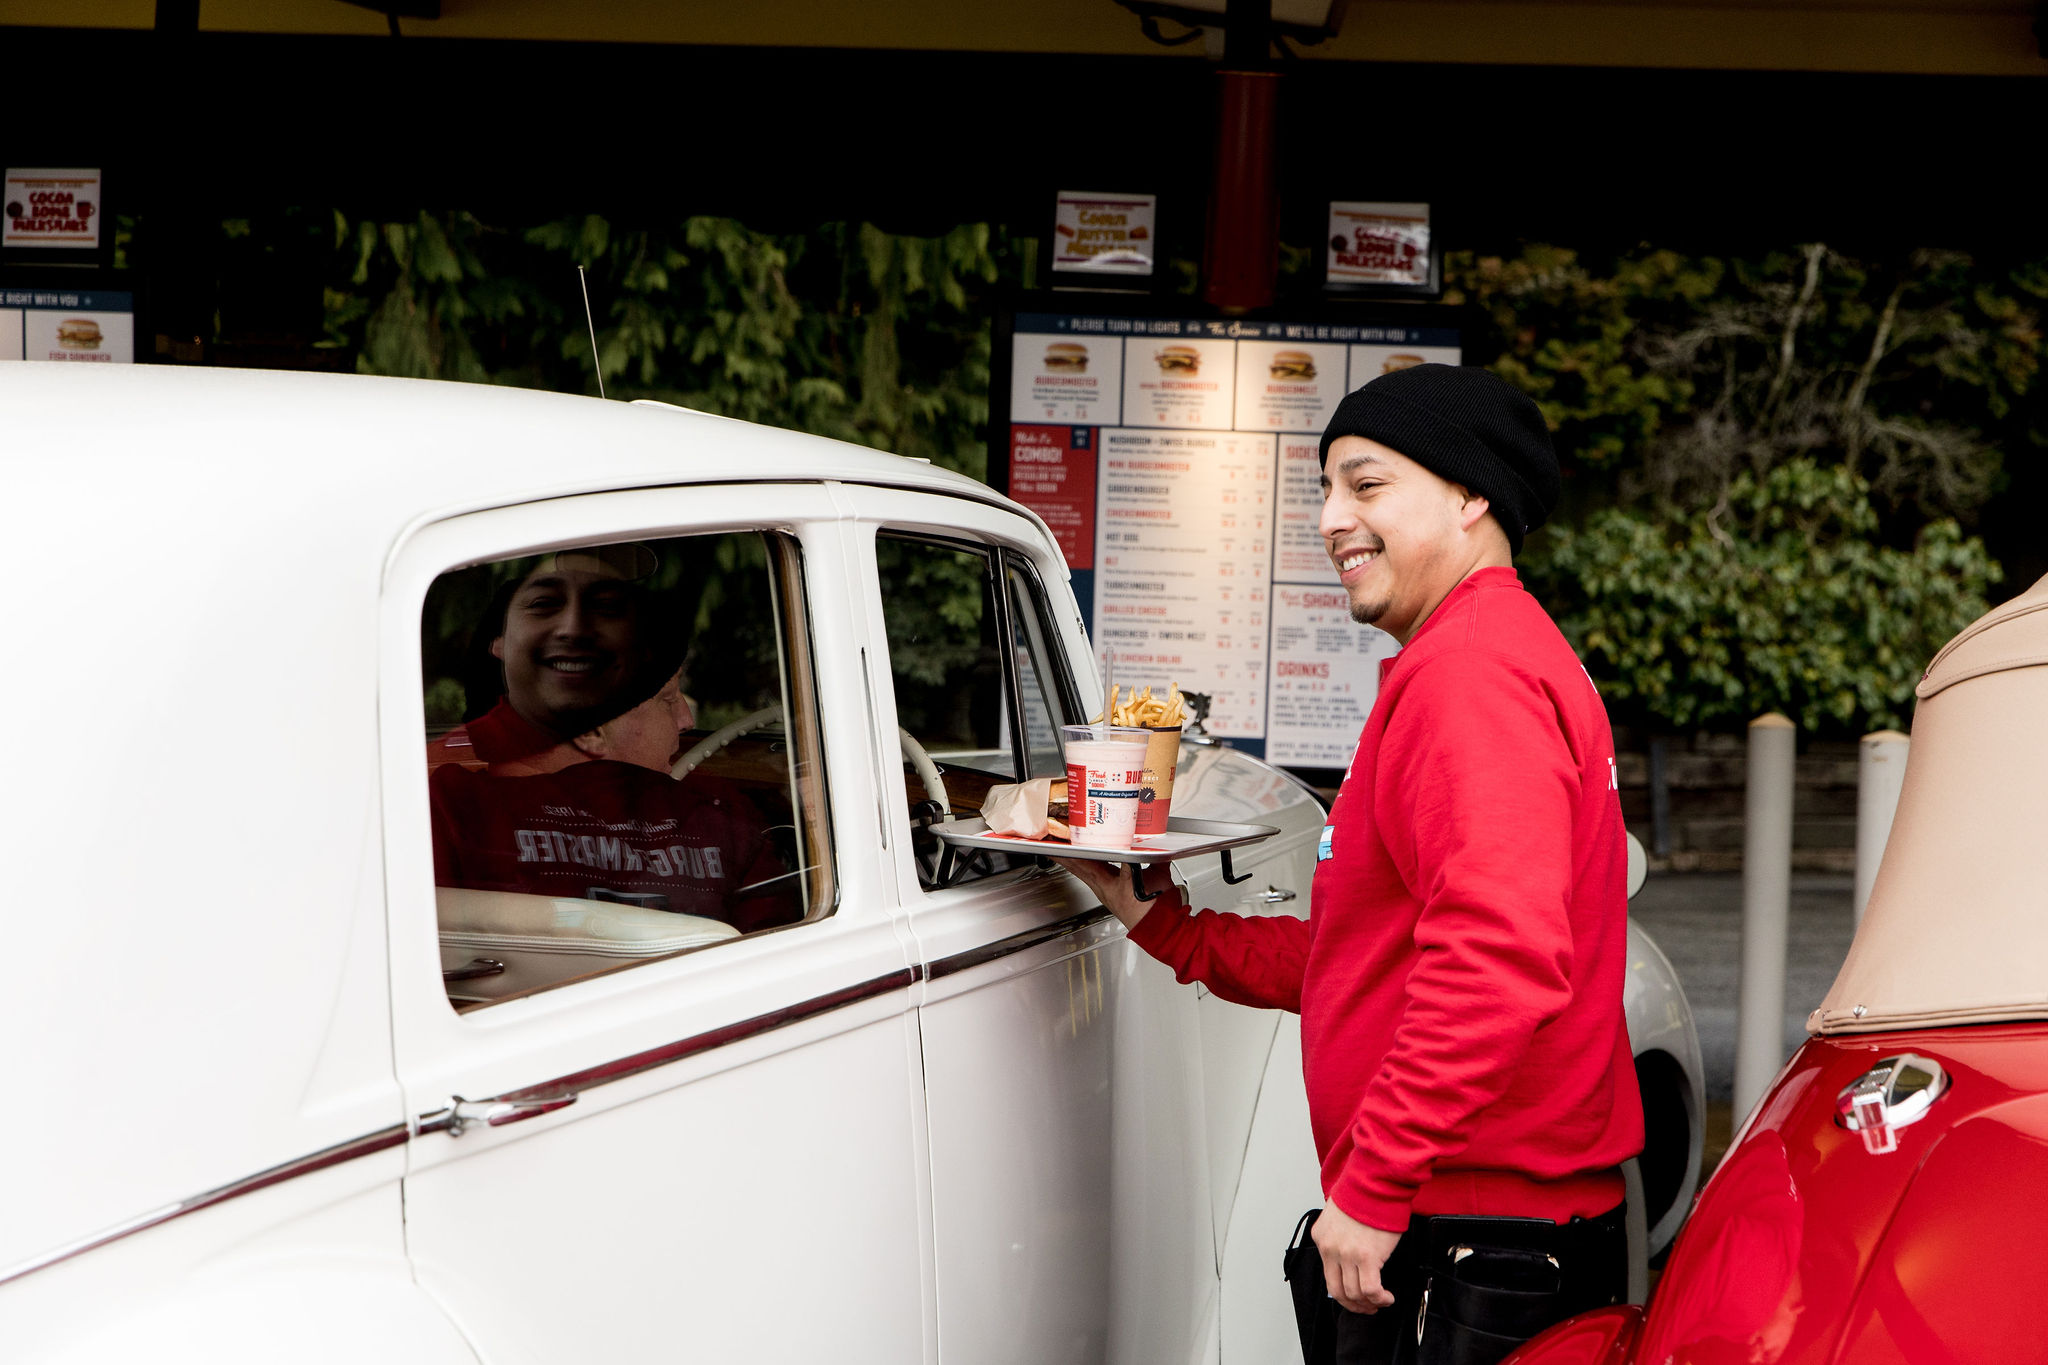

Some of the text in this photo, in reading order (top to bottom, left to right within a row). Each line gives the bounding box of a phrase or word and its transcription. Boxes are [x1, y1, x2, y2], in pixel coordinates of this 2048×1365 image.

[29, 192, 74, 204] COCOA
[6, 292, 33, 304] RIGHT
[34, 293, 58, 305] WITH
[59, 294, 79, 306] YOU
[1070, 318, 1104, 331] PLEASE
[1107, 319, 1131, 332] TURN
[1133, 320, 1146, 332] ON
[1148, 320, 1180, 334] LIGHTS
[1316, 327, 1328, 339] BE
[1331, 328, 1358, 340] RIGHT
[1360, 328, 1385, 340] WITH
[1386, 329, 1406, 341] YOU
[1014, 445, 1063, 463] COMBO!
[1106, 531, 1139, 542] HOT DOG
[1277, 661, 1330, 679] DRINKS
